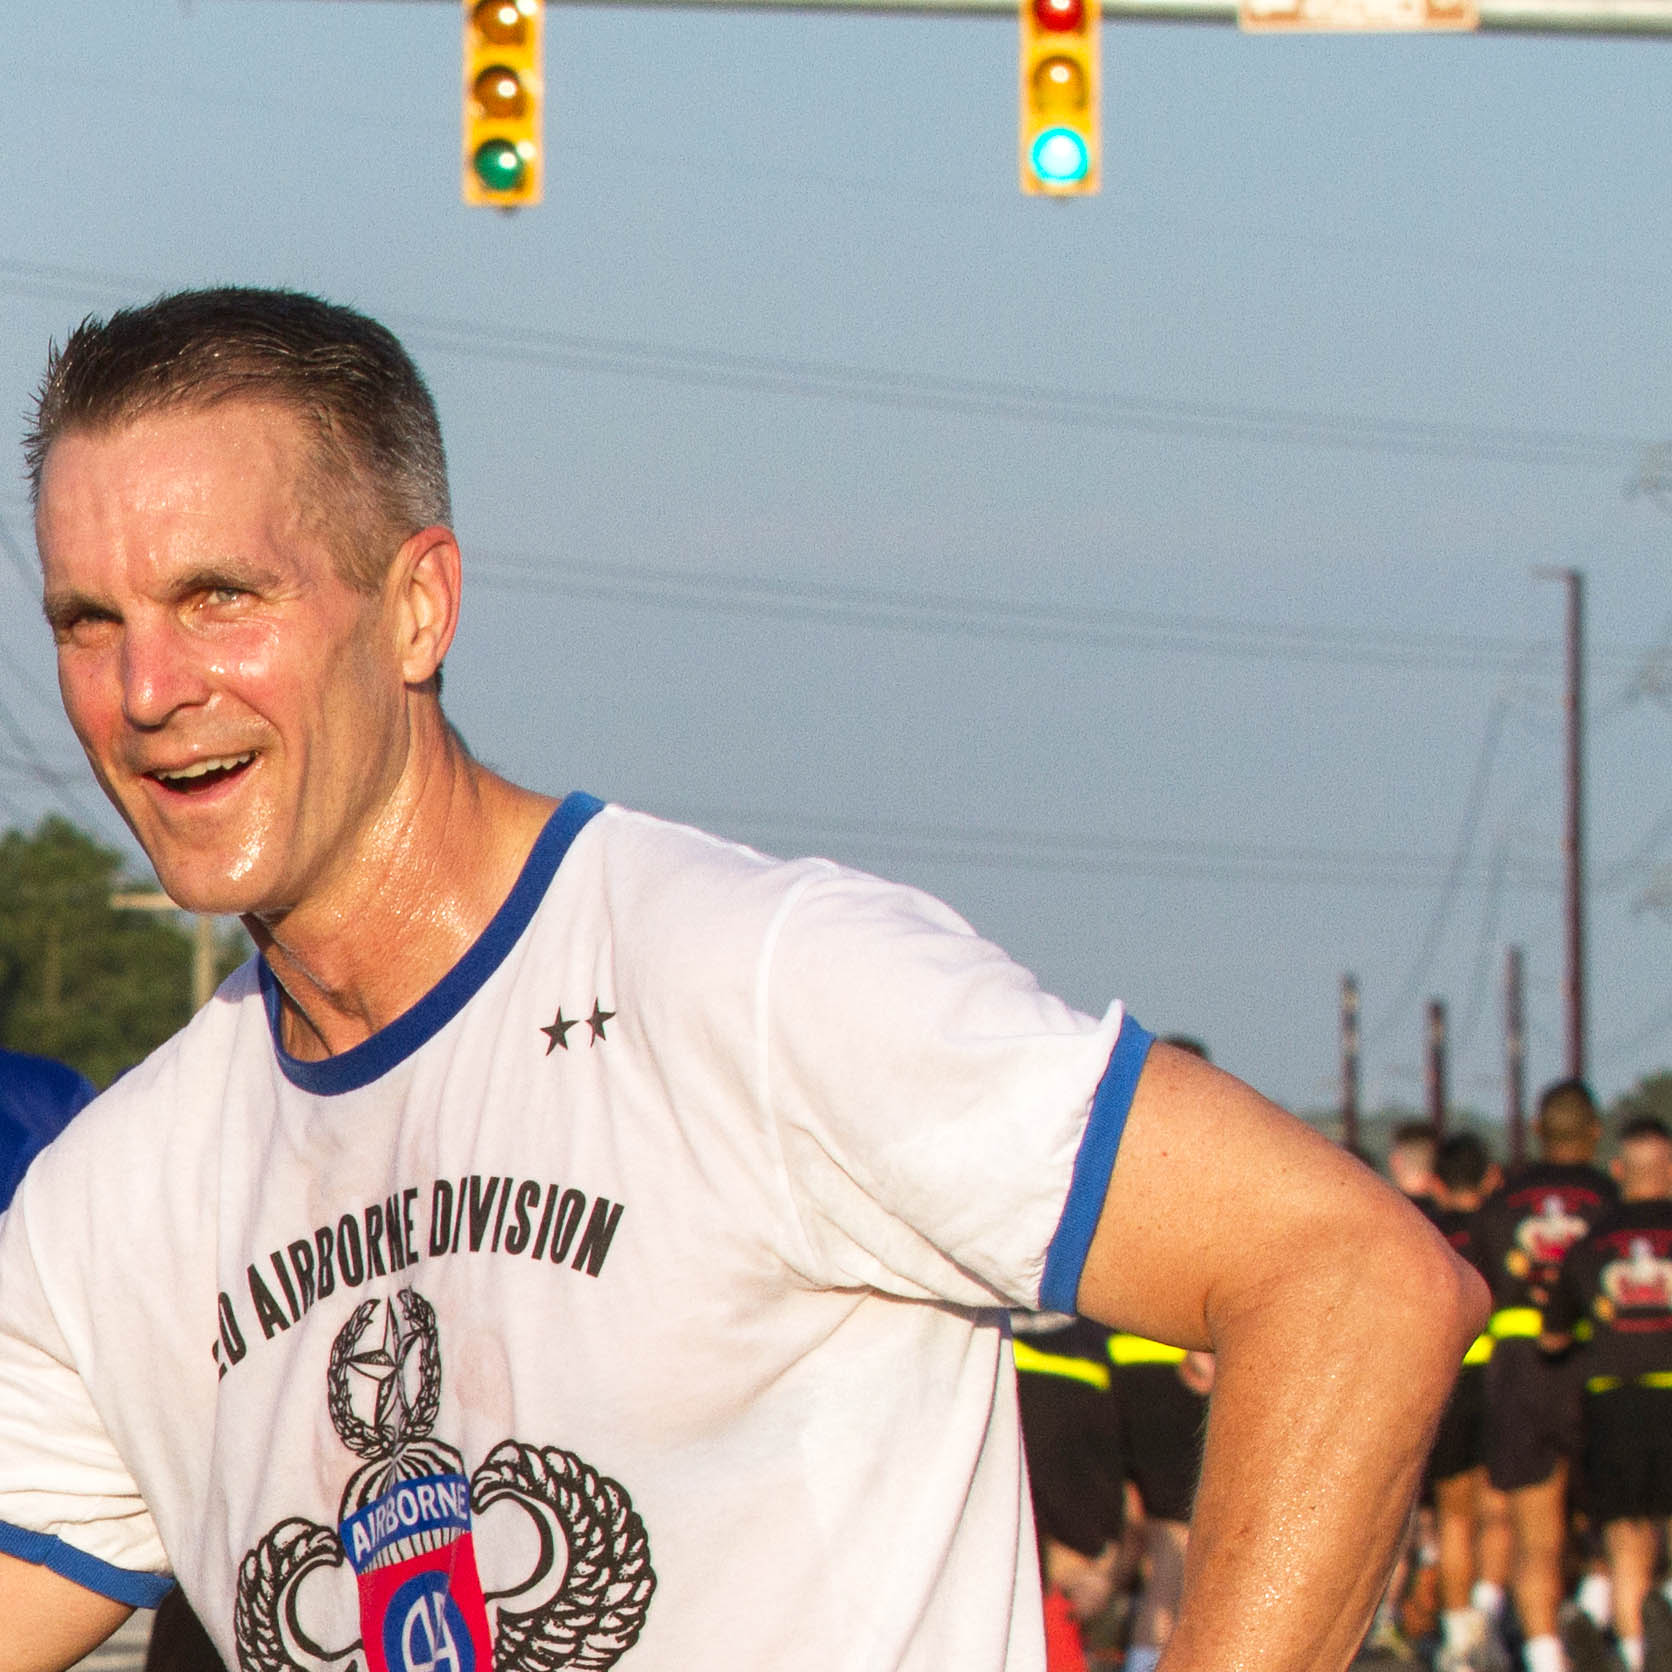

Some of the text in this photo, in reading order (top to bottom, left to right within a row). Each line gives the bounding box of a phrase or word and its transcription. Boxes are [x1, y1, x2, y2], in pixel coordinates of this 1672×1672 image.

[247, 1187, 420, 1341] AIRBORNE
[428, 1174, 626, 1278] DIVISION
[351, 1480, 471, 1564] AIRBORNE
